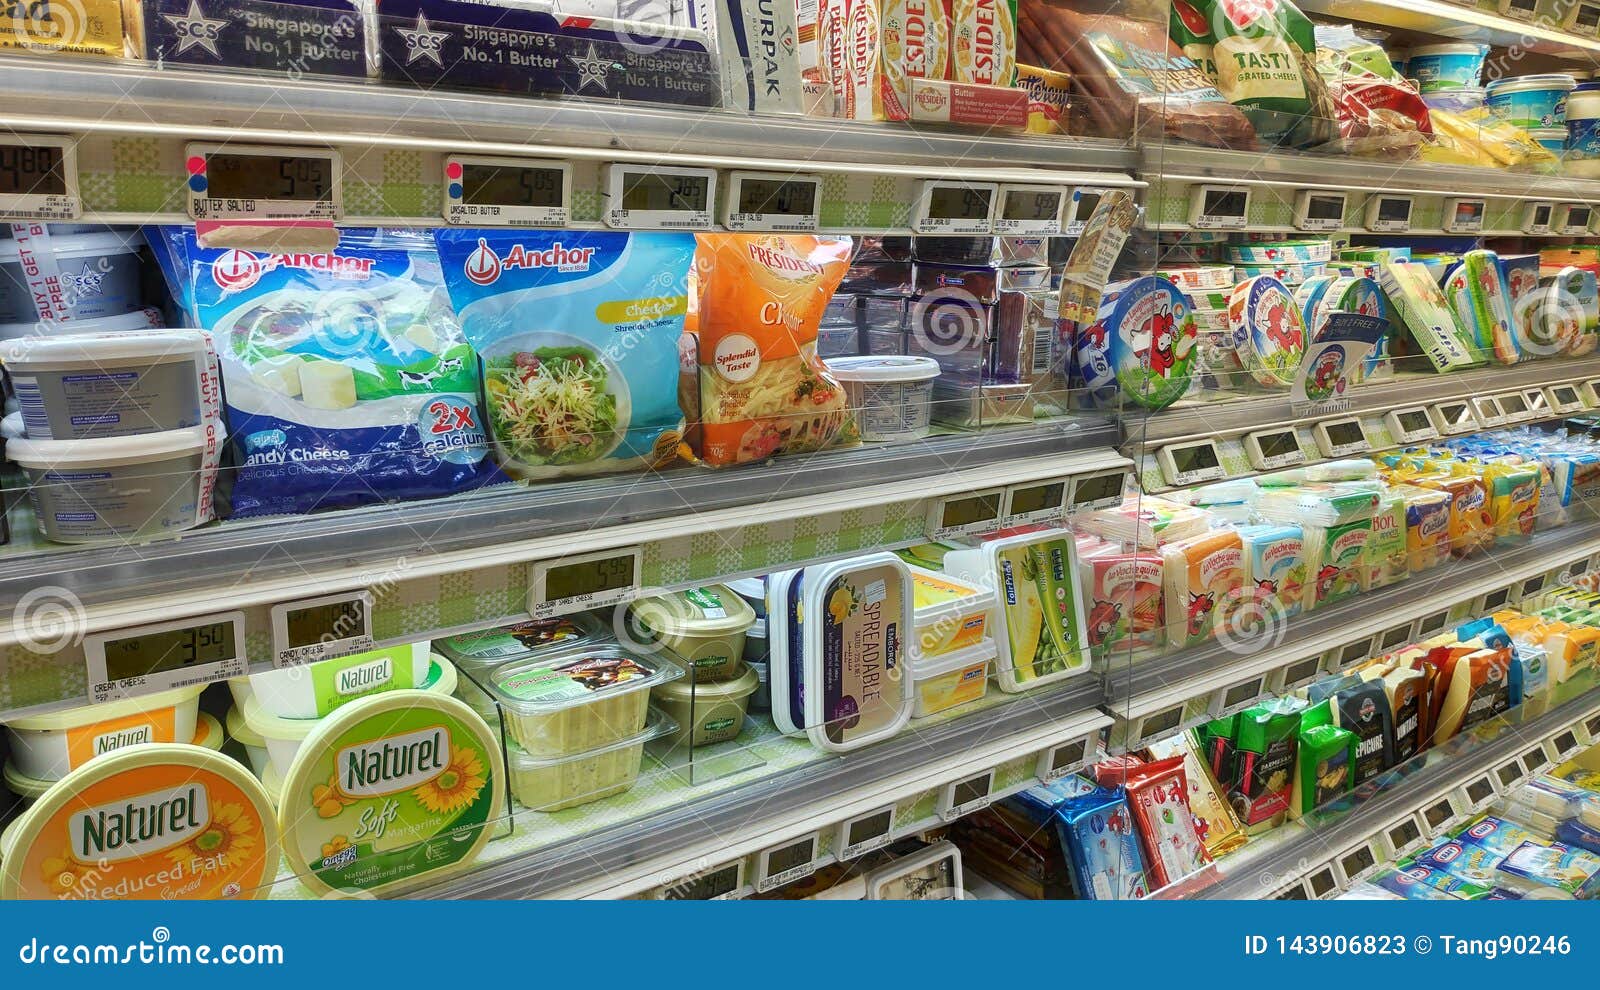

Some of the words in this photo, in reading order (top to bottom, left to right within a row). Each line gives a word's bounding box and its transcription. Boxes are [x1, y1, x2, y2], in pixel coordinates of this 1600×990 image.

[174, 20, 219, 41] SCS
[245, 12, 356, 39] Singapore's
[463, 24, 556, 47] Singapore's
[31, 42, 106, 55] PRESERVATIVES
[283, 40, 292, 54] 1
[301, 41, 360, 61] Butter
[406, 33, 442, 50] SCS
[463, 46, 493, 62] No.
[496, 50, 503, 63] 1
[510, 51, 559, 68] Butter
[625, 52, 703, 73] Singapore's
[1232, 52, 1292, 70] TASTY
[578, 62, 608, 77] SCS
[1238, 72, 1271, 82] GRATED
[1272, 72, 1297, 81] CHEESE
[625, 73, 650, 87] No.
[654, 75, 659, 87] 1
[664, 77, 706, 92] Butter
[194, 199, 224, 213] BUTTER
[227, 200, 256, 213] SALTED
[450, 206, 478, 215] UNSALTED
[480, 207, 501, 216] BUTTER
[611, 209, 629, 218] BUTTER
[18, 249, 39, 277] GET
[503, 242, 595, 269] Anchor
[574, 264, 588, 272] 1886
[75, 275, 101, 286] SCS
[45, 275, 67, 312] FREE
[34, 291, 53, 320] BUY
[716, 348, 757, 365] Splendid
[725, 362, 752, 373] Taste
[1094, 355, 1107, 373] 16
[200, 372, 212, 405] BUY
[429, 402, 477, 435] 2x
[206, 424, 216, 457] GET
[424, 432, 488, 457] calcium
[246, 449, 286, 466] andy
[290, 448, 350, 462] Cheese
[199, 475, 214, 518] FREE
[1584, 488, 1598, 497] SCS
[1371, 515, 1398, 532] Bon
[279, 651, 298, 660] CANDY
[862, 601, 881, 704] SPREADABLE
[886, 627, 897, 667] EMBORG
[94, 682, 117, 693] CREAM
[119, 679, 147, 689] CHEESE
[340, 660, 390, 691] Naturel
[97, 726, 150, 754] Naturel
[1355, 733, 1384, 759] EPICURE
[347, 731, 442, 790] Naturel
[82, 787, 200, 855] Naturel
[353, 799, 400, 838] Soft
[386, 815, 442, 838] Margarine
[322, 844, 357, 867] Omega
[88, 862, 183, 899] Reduced
[191, 852, 226, 873] Fat
[344, 864, 381, 881] Naturally
[353, 868, 397, 886] Cholesterol
[398, 862, 416, 872] Free
